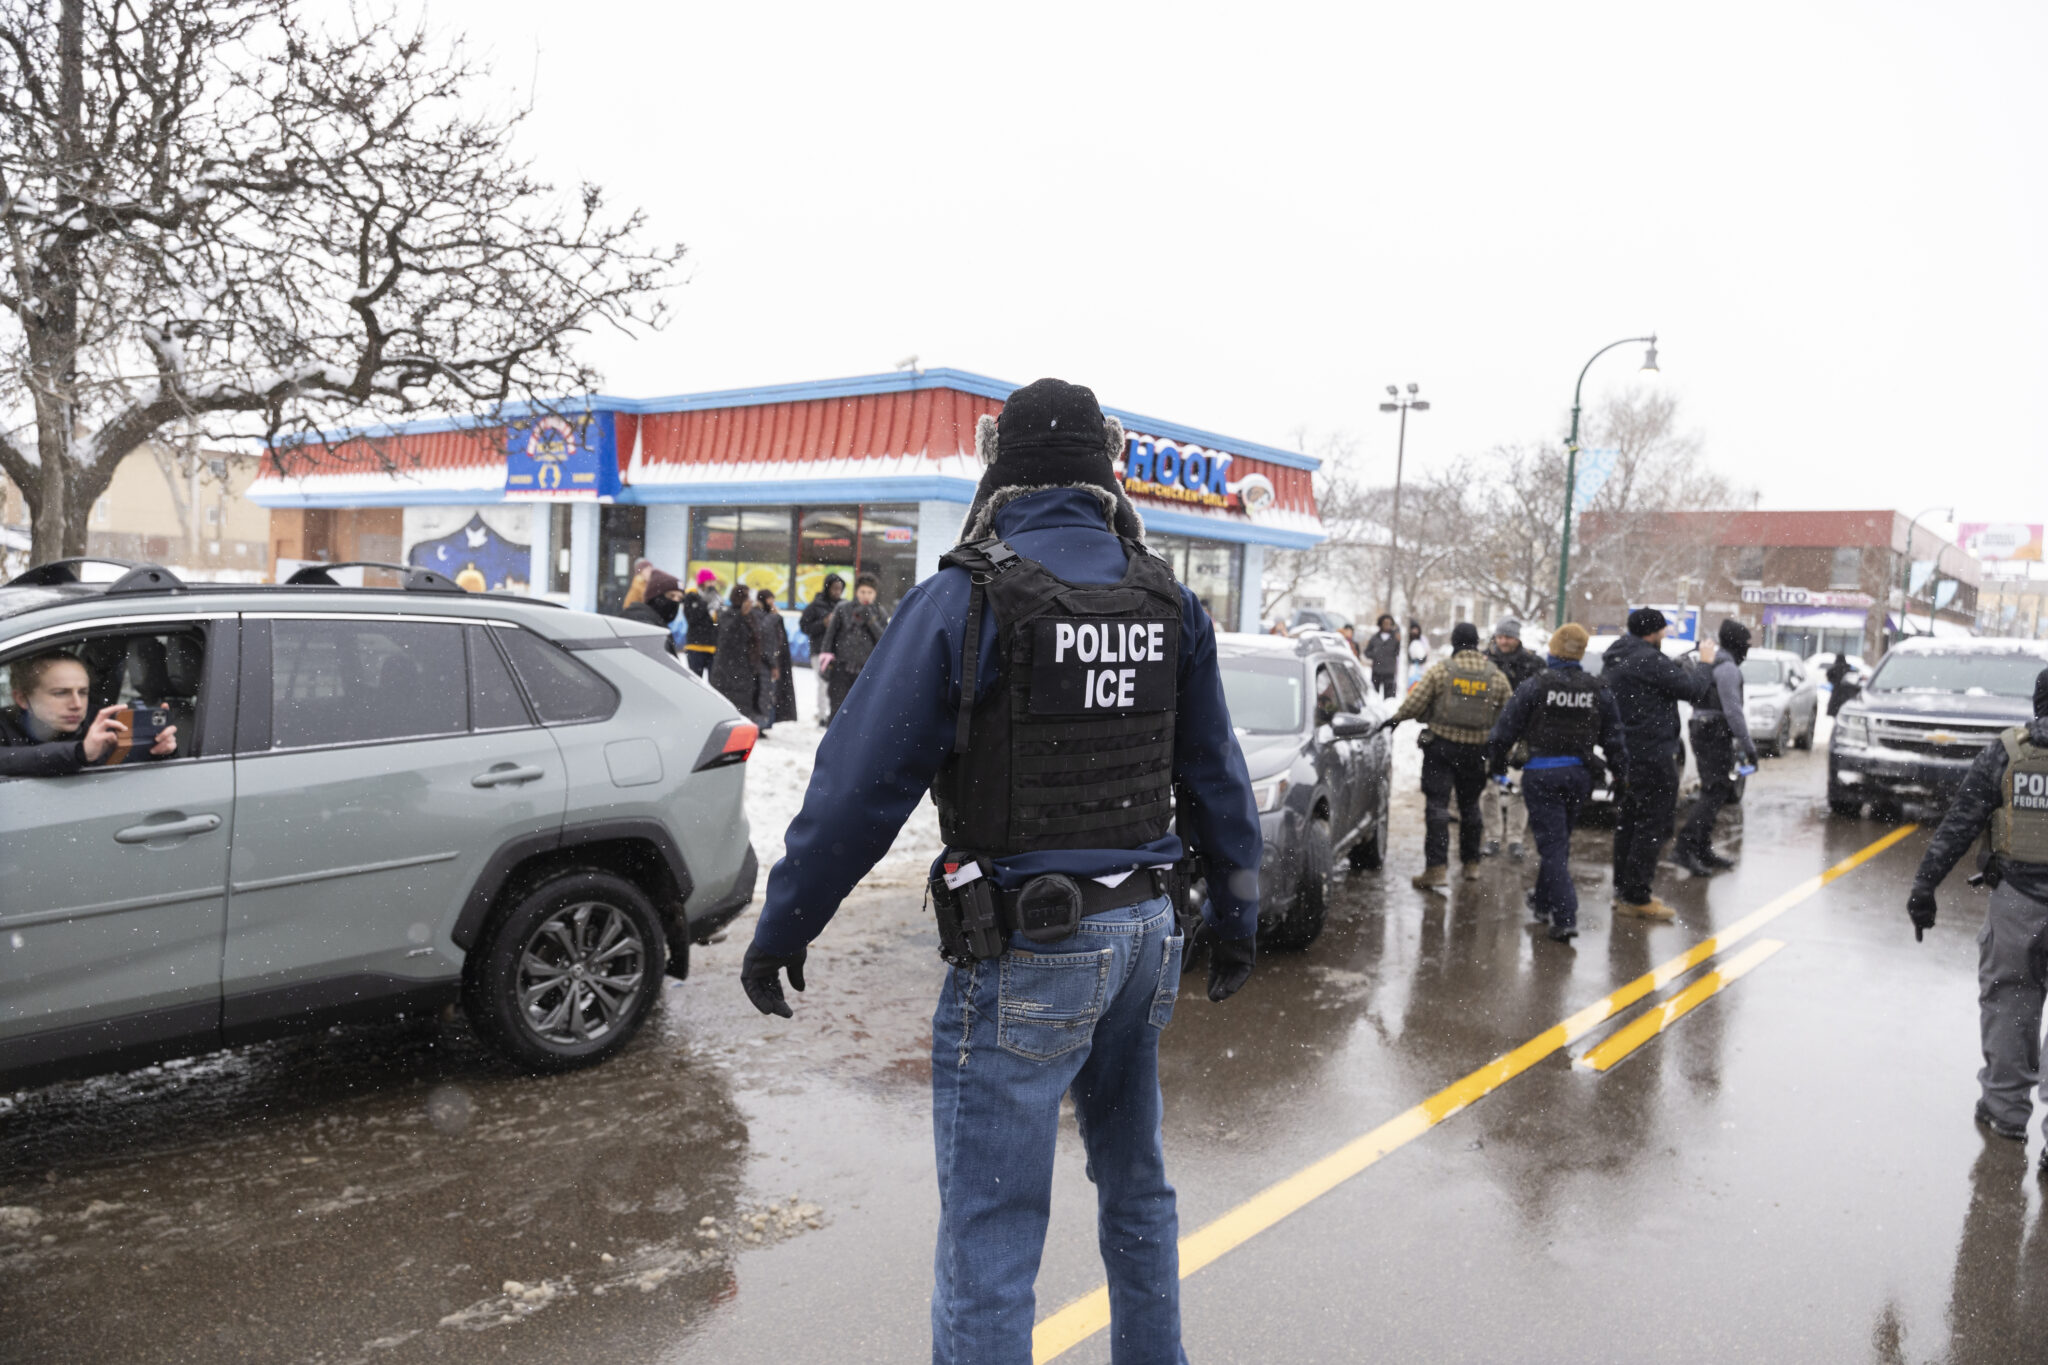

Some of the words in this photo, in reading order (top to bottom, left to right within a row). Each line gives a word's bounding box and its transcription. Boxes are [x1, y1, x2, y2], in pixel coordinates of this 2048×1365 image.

[1126, 438, 1232, 497] HOOK
[1743, 587, 1807, 604] metro
[1055, 623, 1164, 663] POLICE
[1084, 669, 1136, 708] ICE
[1546, 690, 1594, 708] POLICE
[2013, 773, 2048, 796] PO
